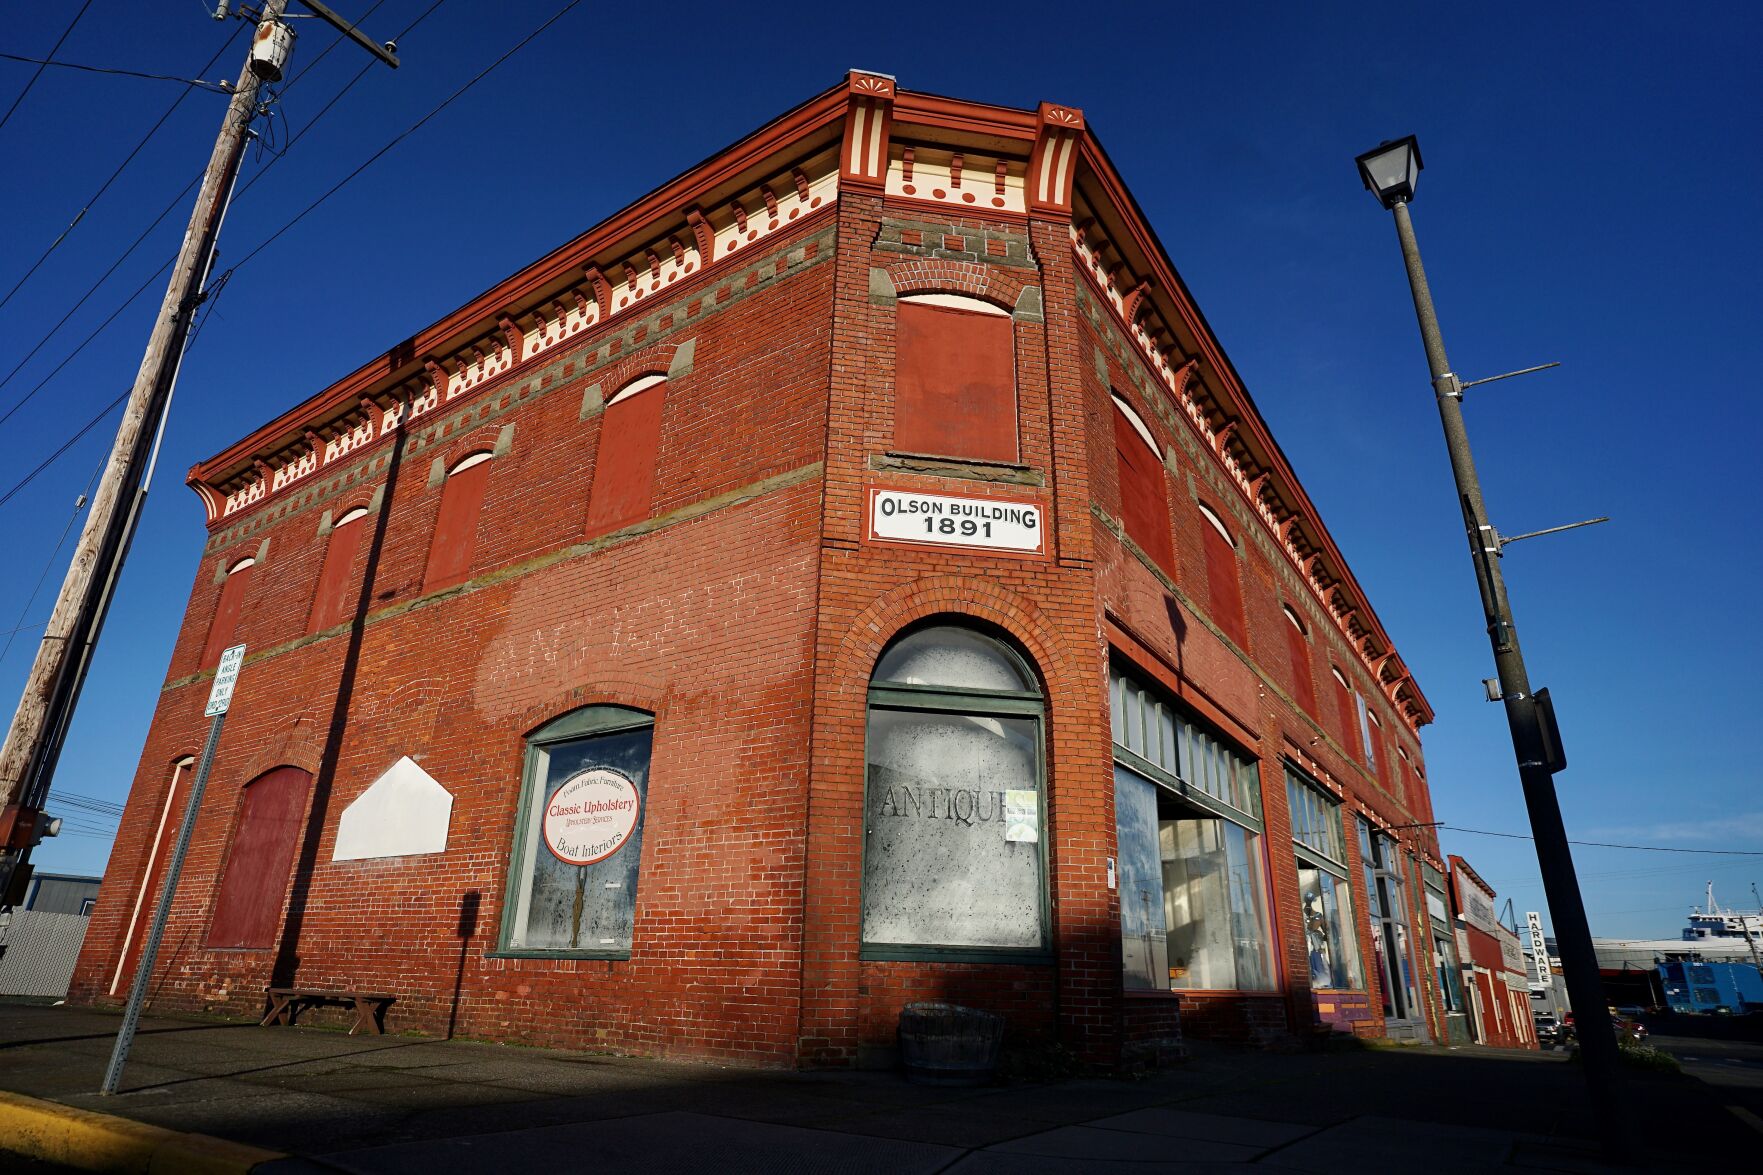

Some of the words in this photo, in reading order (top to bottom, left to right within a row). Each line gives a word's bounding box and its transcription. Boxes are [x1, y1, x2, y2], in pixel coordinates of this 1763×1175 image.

[881, 498, 943, 516] OLSON
[950, 503, 1036, 529] BUILDING
[924, 516, 991, 538] 1891
[549, 803, 581, 817] Classic
[584, 799, 634, 815] Upholstery
[557, 837, 579, 857] Boat
[581, 831, 623, 858] Interiors
[1529, 914, 1549, 982] HARDWARE
